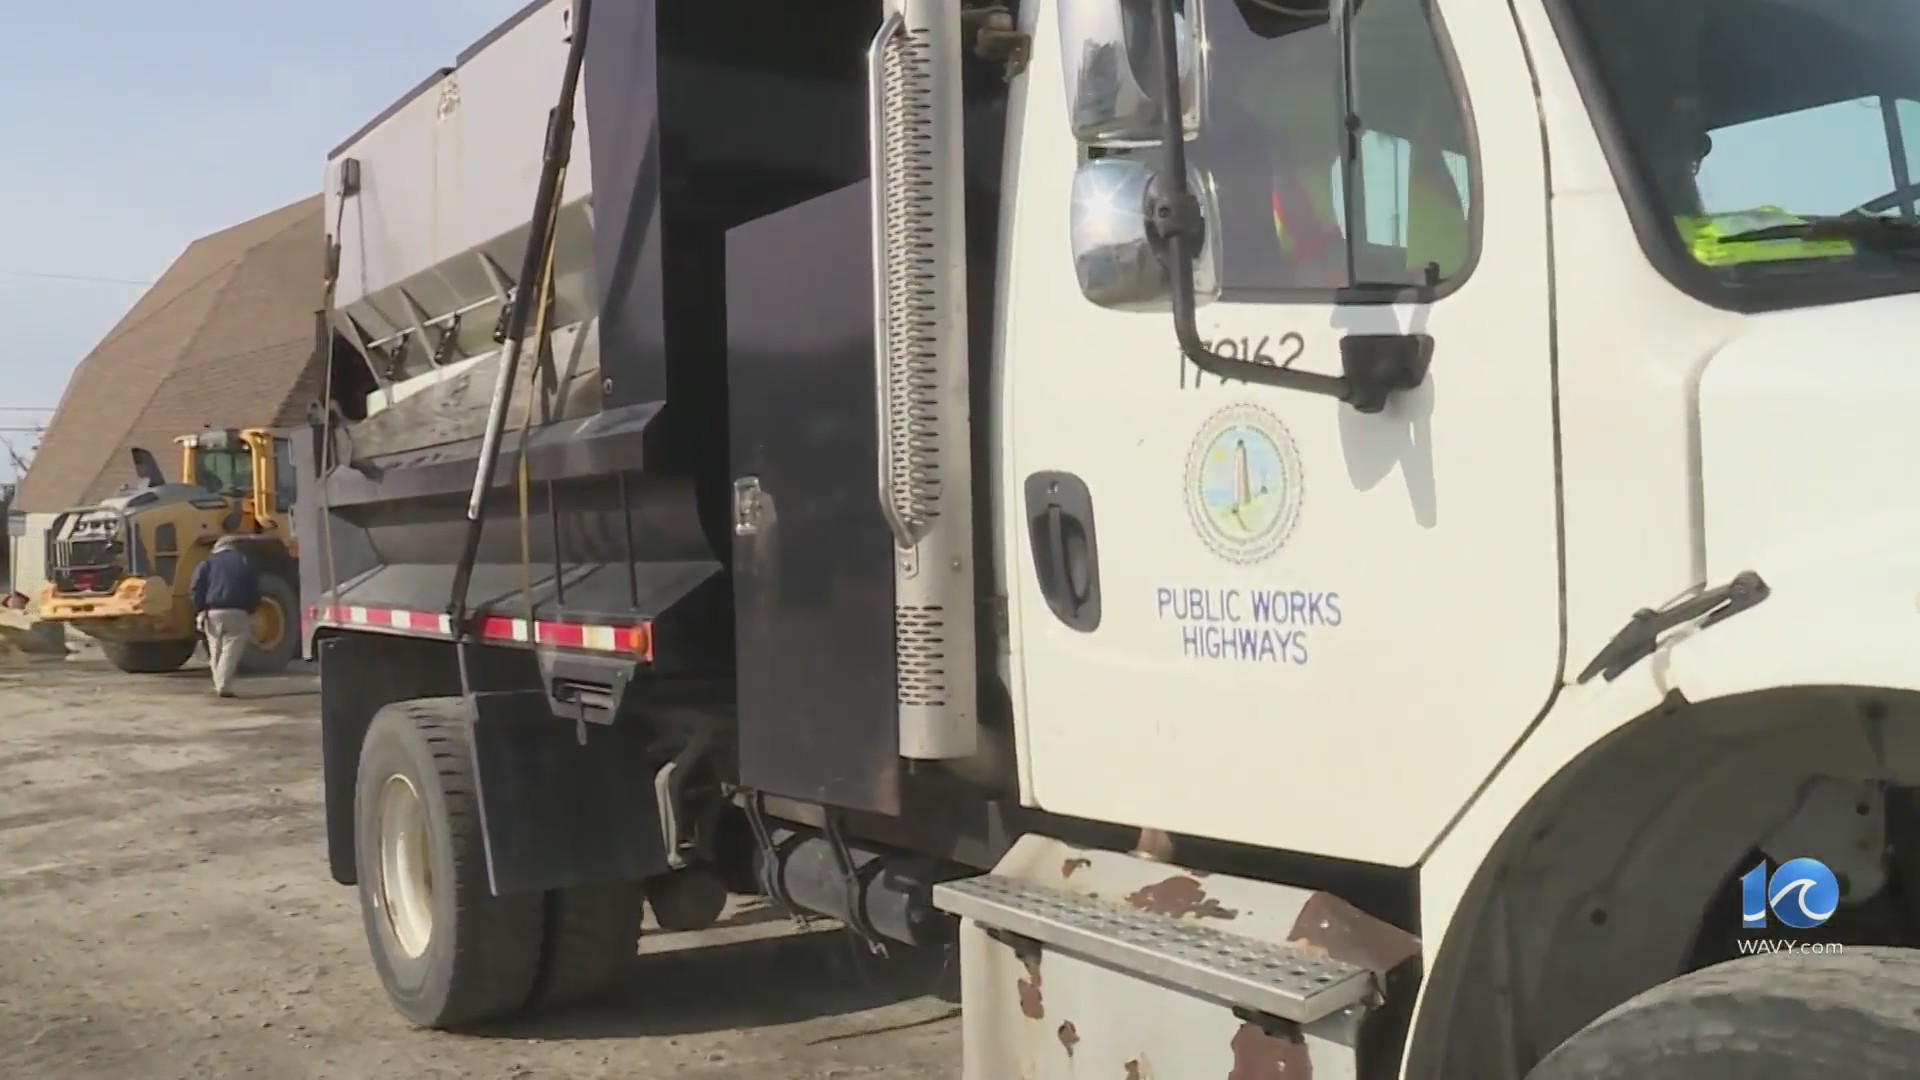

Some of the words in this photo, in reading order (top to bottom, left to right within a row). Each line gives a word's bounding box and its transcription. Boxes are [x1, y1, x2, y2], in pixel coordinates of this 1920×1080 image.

[1157, 587, 1241, 622] PUBLIC
[1251, 589, 1342, 627] WORKS
[1182, 625, 1308, 665] HIGHWAYS
